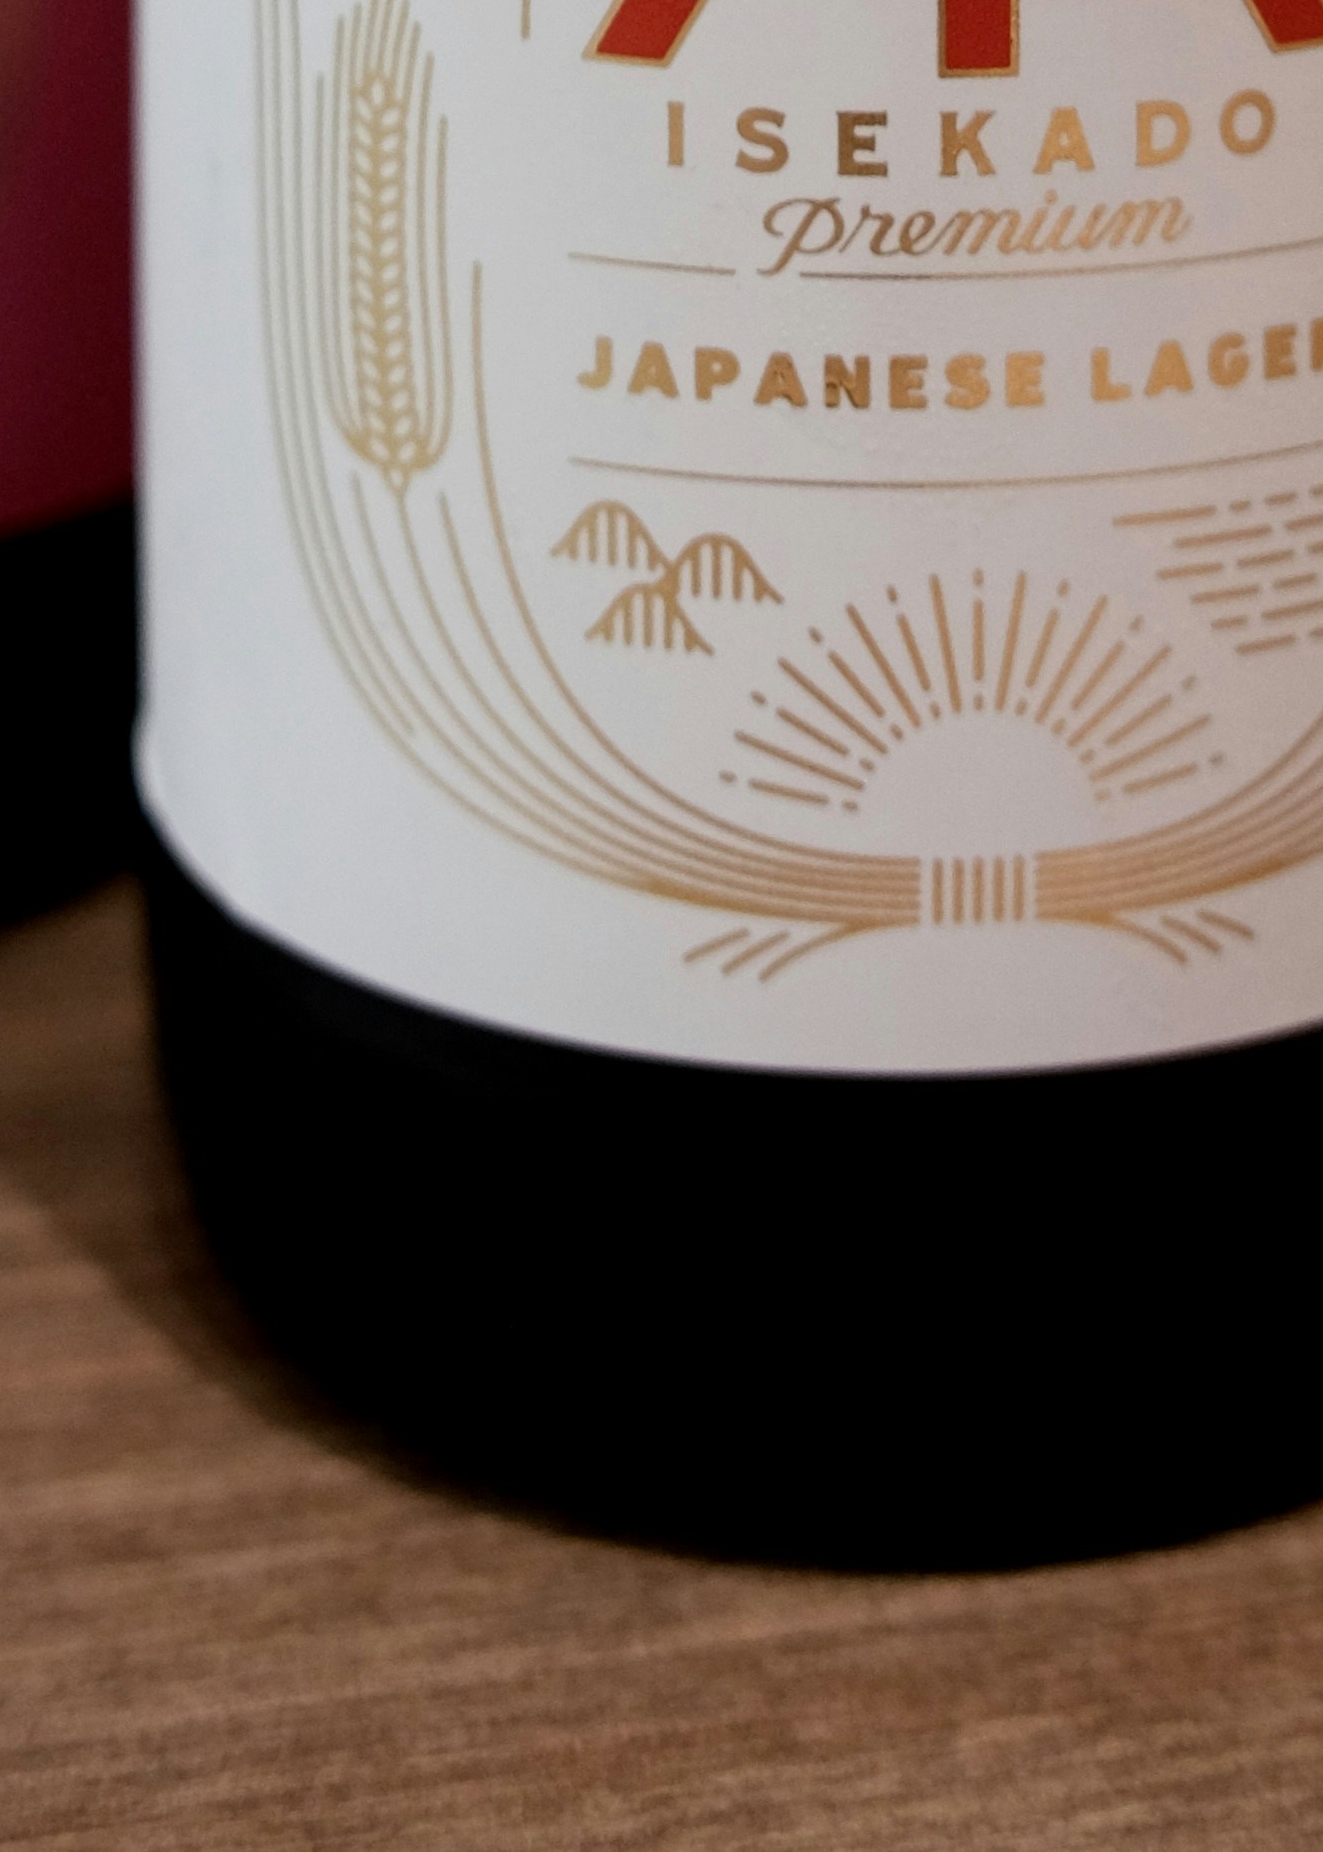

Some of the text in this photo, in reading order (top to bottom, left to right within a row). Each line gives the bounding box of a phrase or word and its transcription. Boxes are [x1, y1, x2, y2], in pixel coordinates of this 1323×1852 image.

[666, 87, 1277, 178] ISEKADO
[756, 189, 1194, 277] Premium
[576, 334, 1047, 410] JAPANESE
